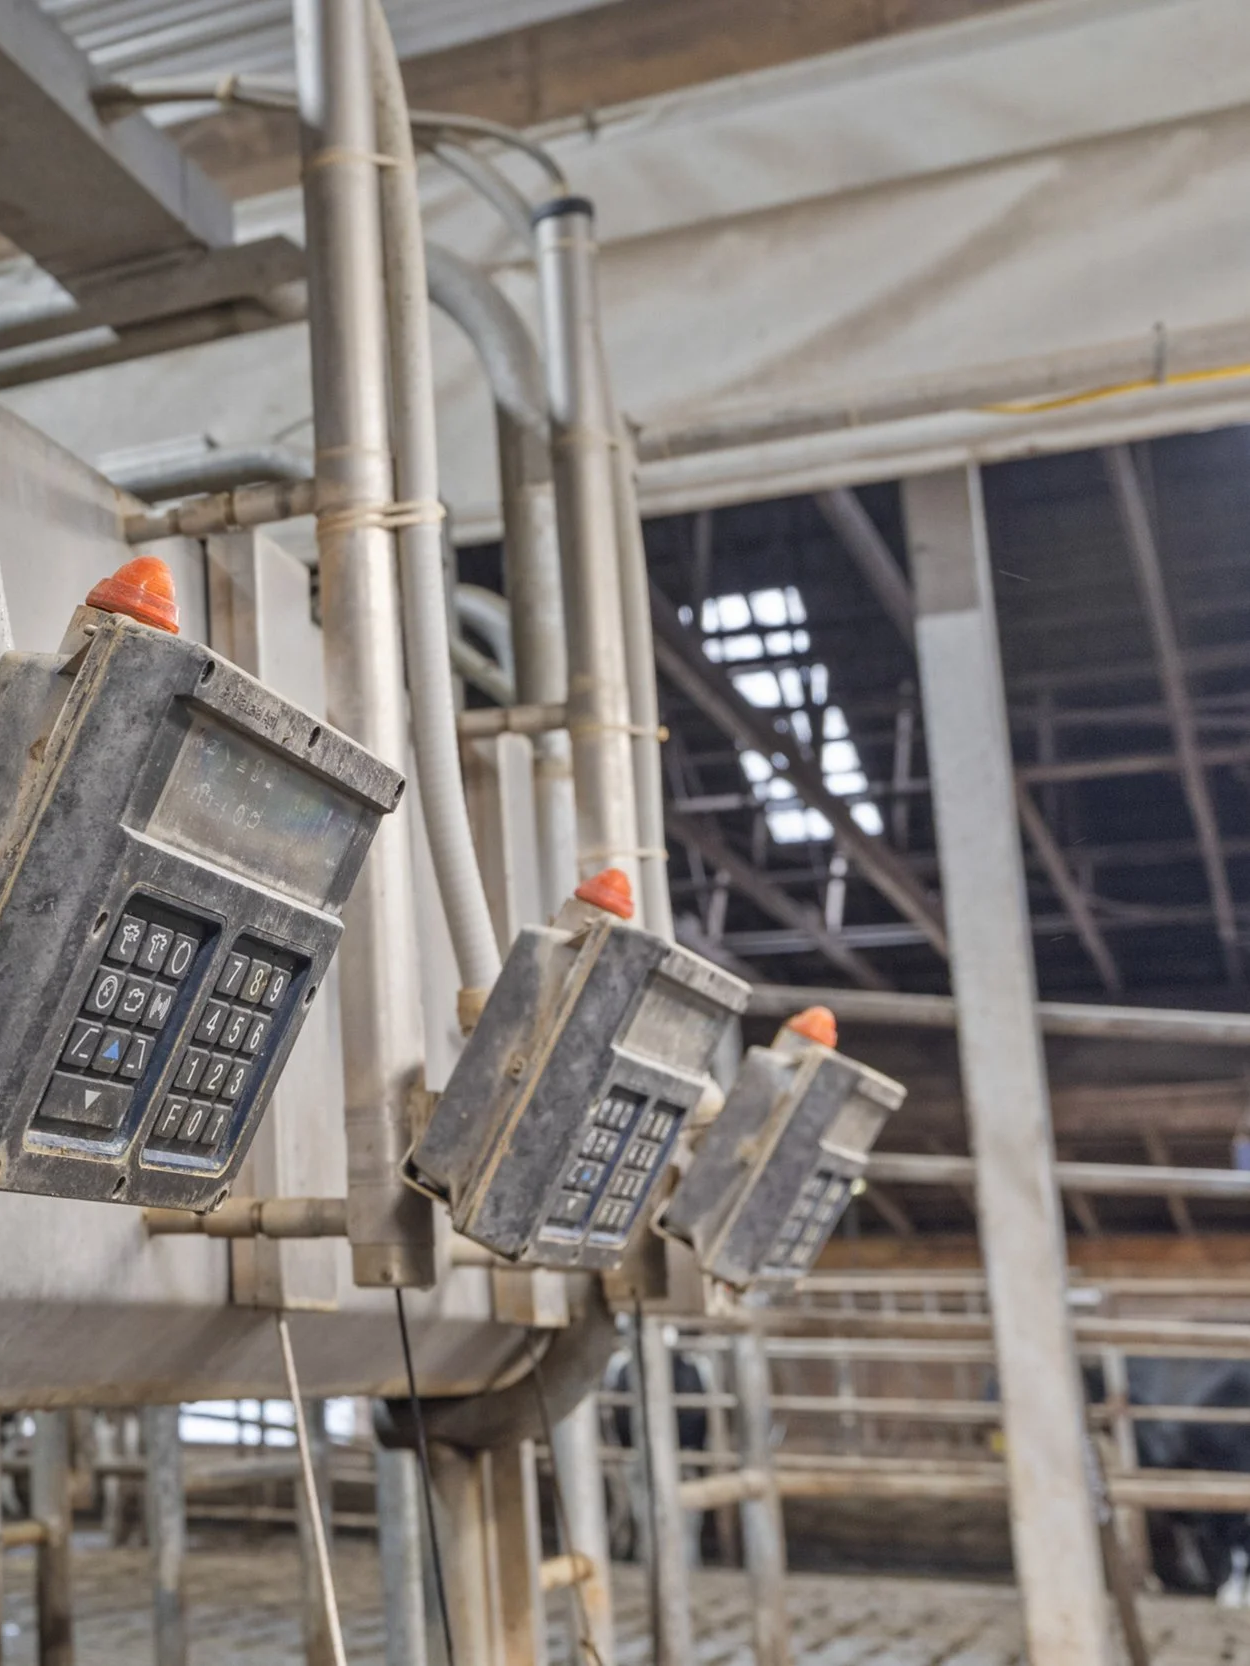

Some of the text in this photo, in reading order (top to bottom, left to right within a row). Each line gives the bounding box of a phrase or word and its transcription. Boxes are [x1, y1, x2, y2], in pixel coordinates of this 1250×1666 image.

[226, 960, 284, 1003] 7 8 9
[206, 1008, 264, 1050] 4 5 6
[186, 1057, 245, 1095] 1 2 3
[161, 1103, 182, 1132] F
